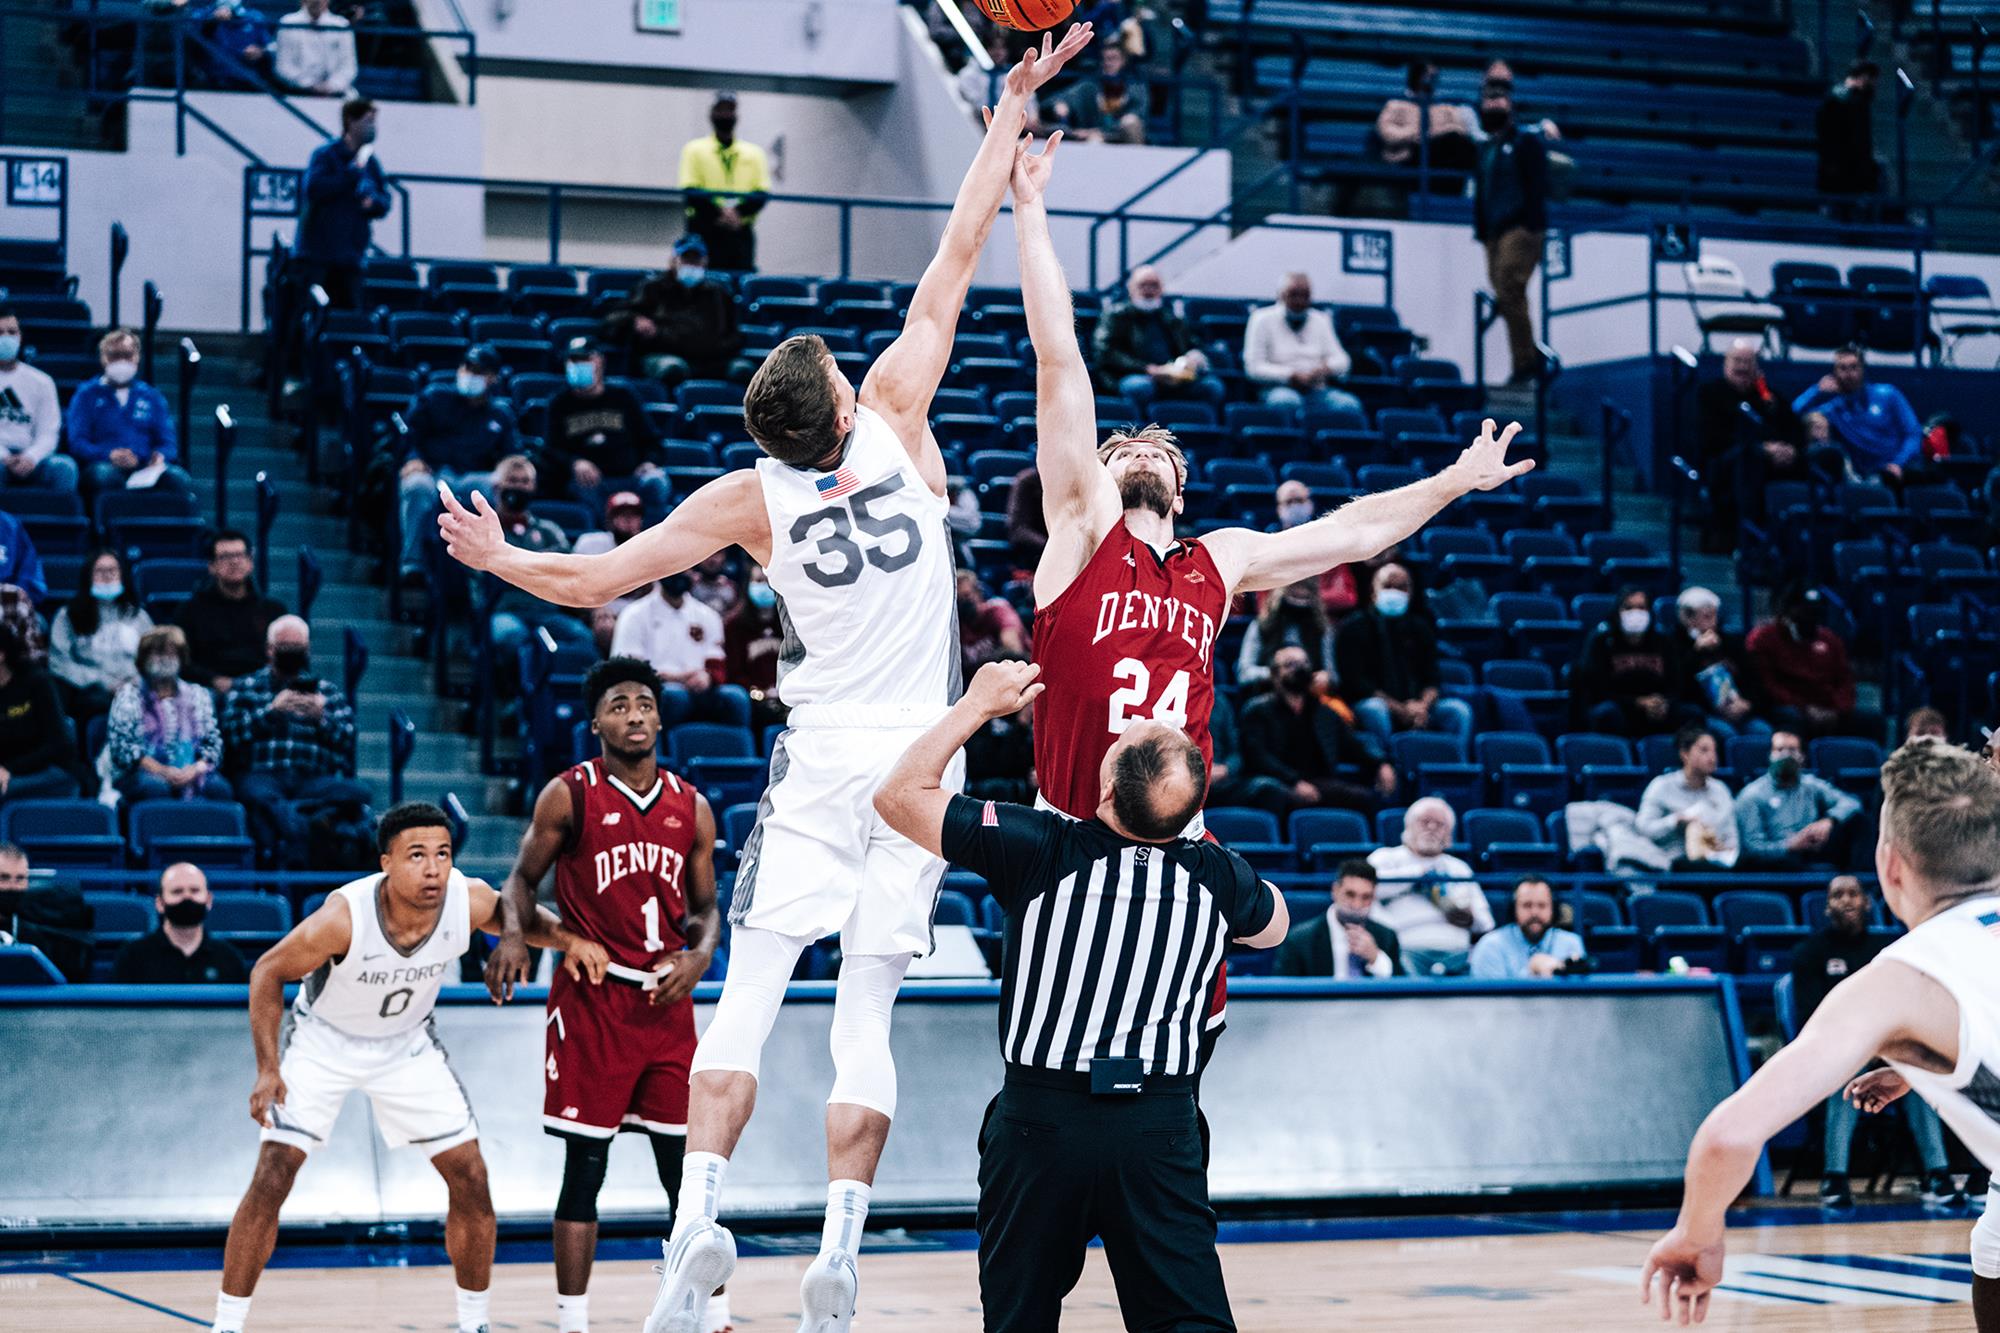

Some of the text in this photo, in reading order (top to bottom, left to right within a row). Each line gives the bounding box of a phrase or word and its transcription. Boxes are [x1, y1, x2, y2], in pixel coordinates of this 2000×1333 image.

[14, 161, 59, 191] L14
[788, 471, 924, 589] 35
[1091, 589, 1215, 675] DENVER
[1107, 656, 1191, 735] 24
[640, 895, 665, 953] 1
[356, 969, 389, 985] AIR
[378, 986, 415, 1019] 0
